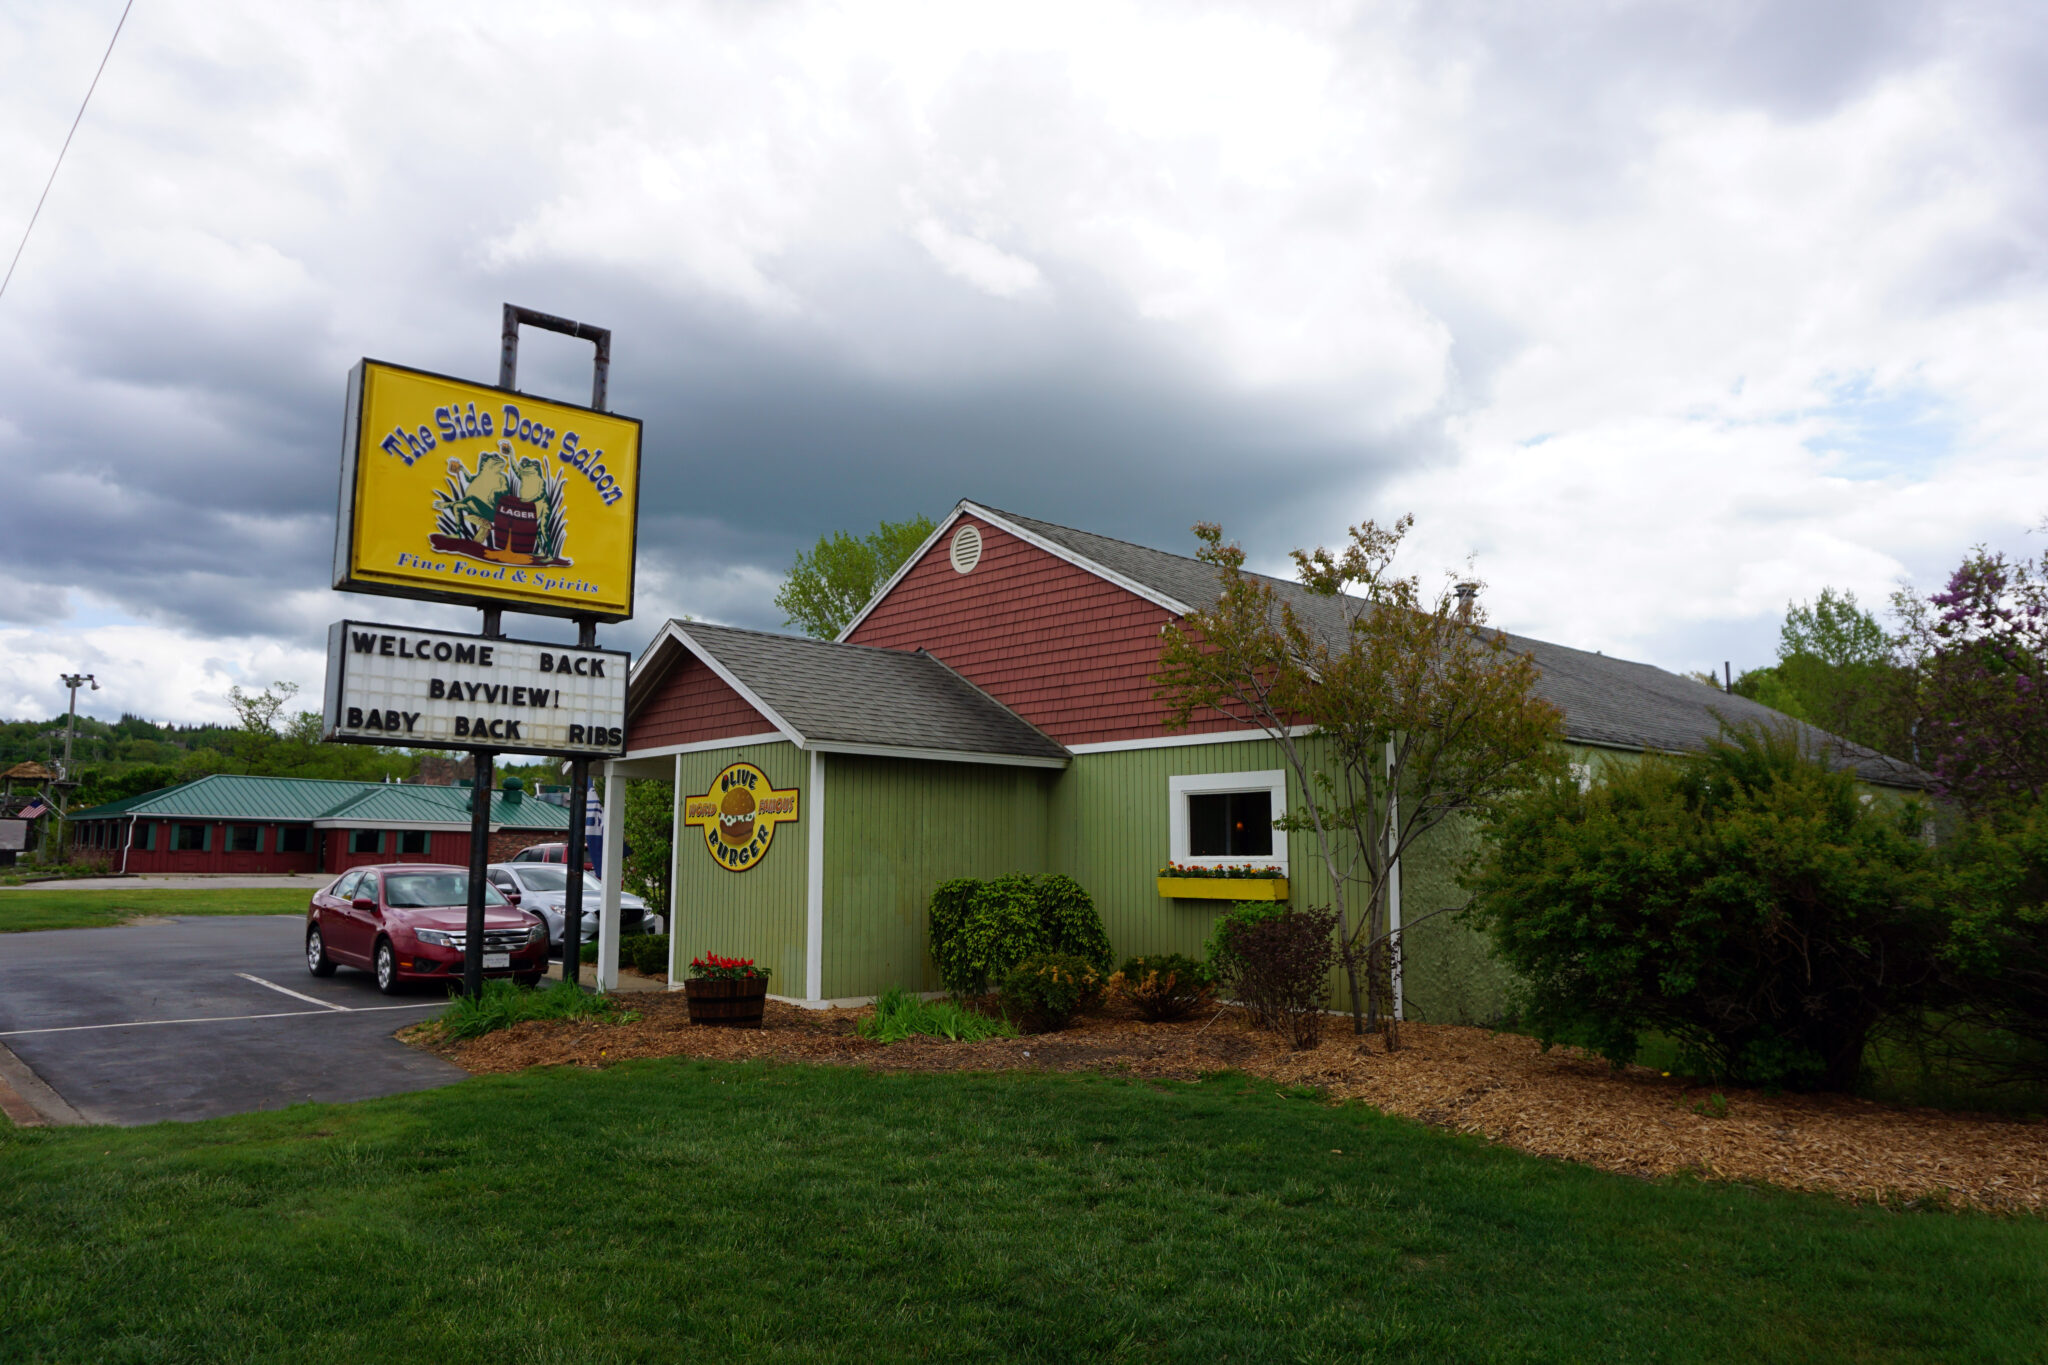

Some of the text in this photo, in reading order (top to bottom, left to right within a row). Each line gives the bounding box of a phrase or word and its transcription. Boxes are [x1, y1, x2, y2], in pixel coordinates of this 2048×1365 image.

[380, 402, 624, 507] The Side Door Saloon
[500, 505, 536, 519] LAGER
[396, 552, 599, 594] Fine Food & Spirits
[352, 631, 606, 678] WELCOME BACK
[430, 678, 560, 709] BAYVIEW!
[347, 707, 622, 746] BABY BACK RIBS
[721, 769, 758, 793] OLIVE
[688, 796, 794, 818] WORLD FAMOUS
[708, 824, 769, 867] BURGER
